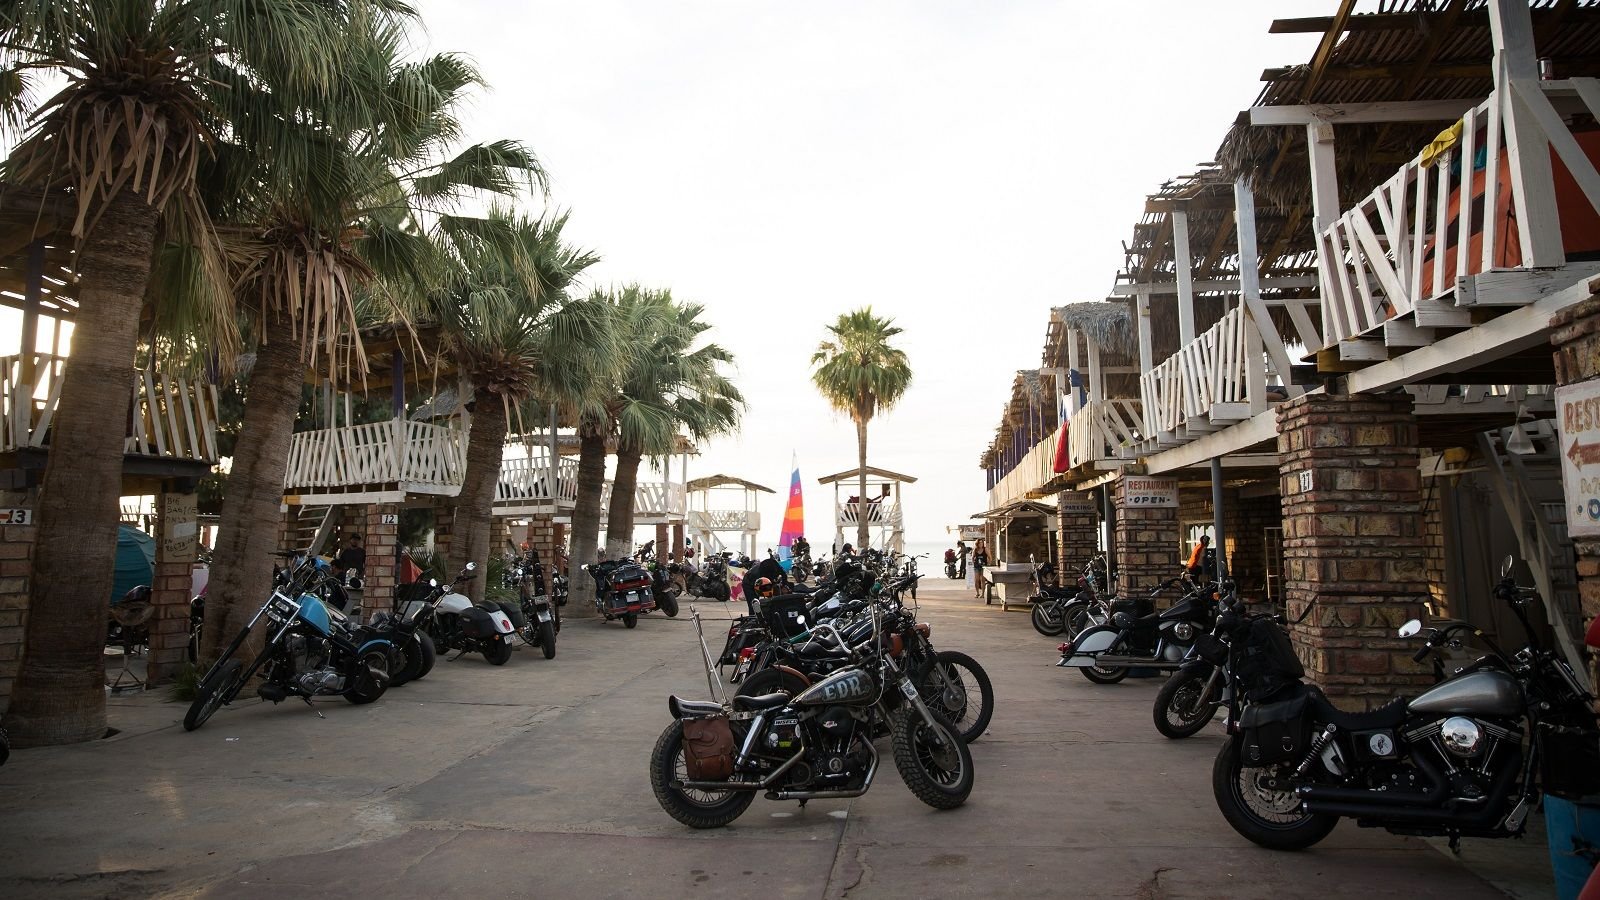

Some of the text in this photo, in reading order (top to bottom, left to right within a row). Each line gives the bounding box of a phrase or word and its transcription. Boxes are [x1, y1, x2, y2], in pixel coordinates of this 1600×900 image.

[1128, 480, 1175, 490] RESTAURANT
[1134, 496, 1165, 504] OPEN
[6, 510, 26, 523] 13
[385, 515, 394, 523] 12
